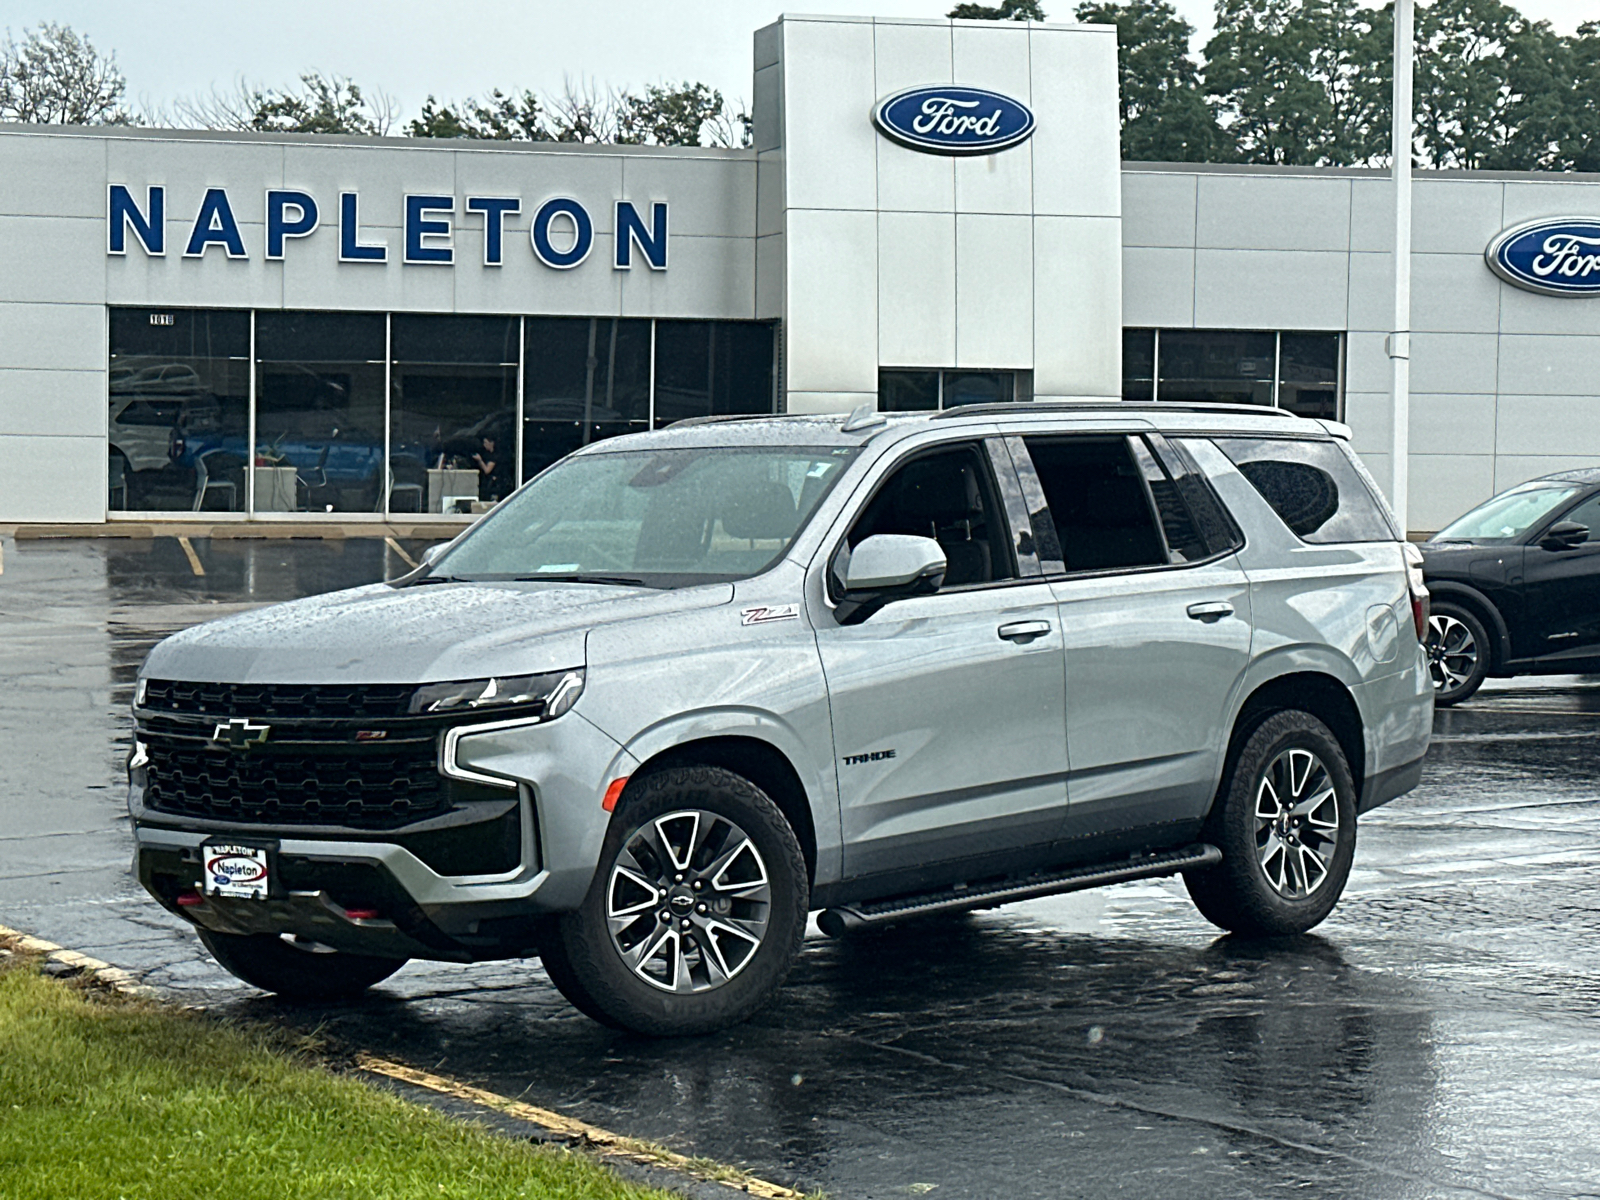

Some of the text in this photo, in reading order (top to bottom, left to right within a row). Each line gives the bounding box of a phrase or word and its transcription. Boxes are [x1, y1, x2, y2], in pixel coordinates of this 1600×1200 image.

[913, 97, 1002, 136] Ford
[107, 184, 669, 270] NAPLETON
[1532, 234, 1600, 277] For
[842, 749, 896, 765] TAHOE
[217, 861, 258, 877] Napleton
